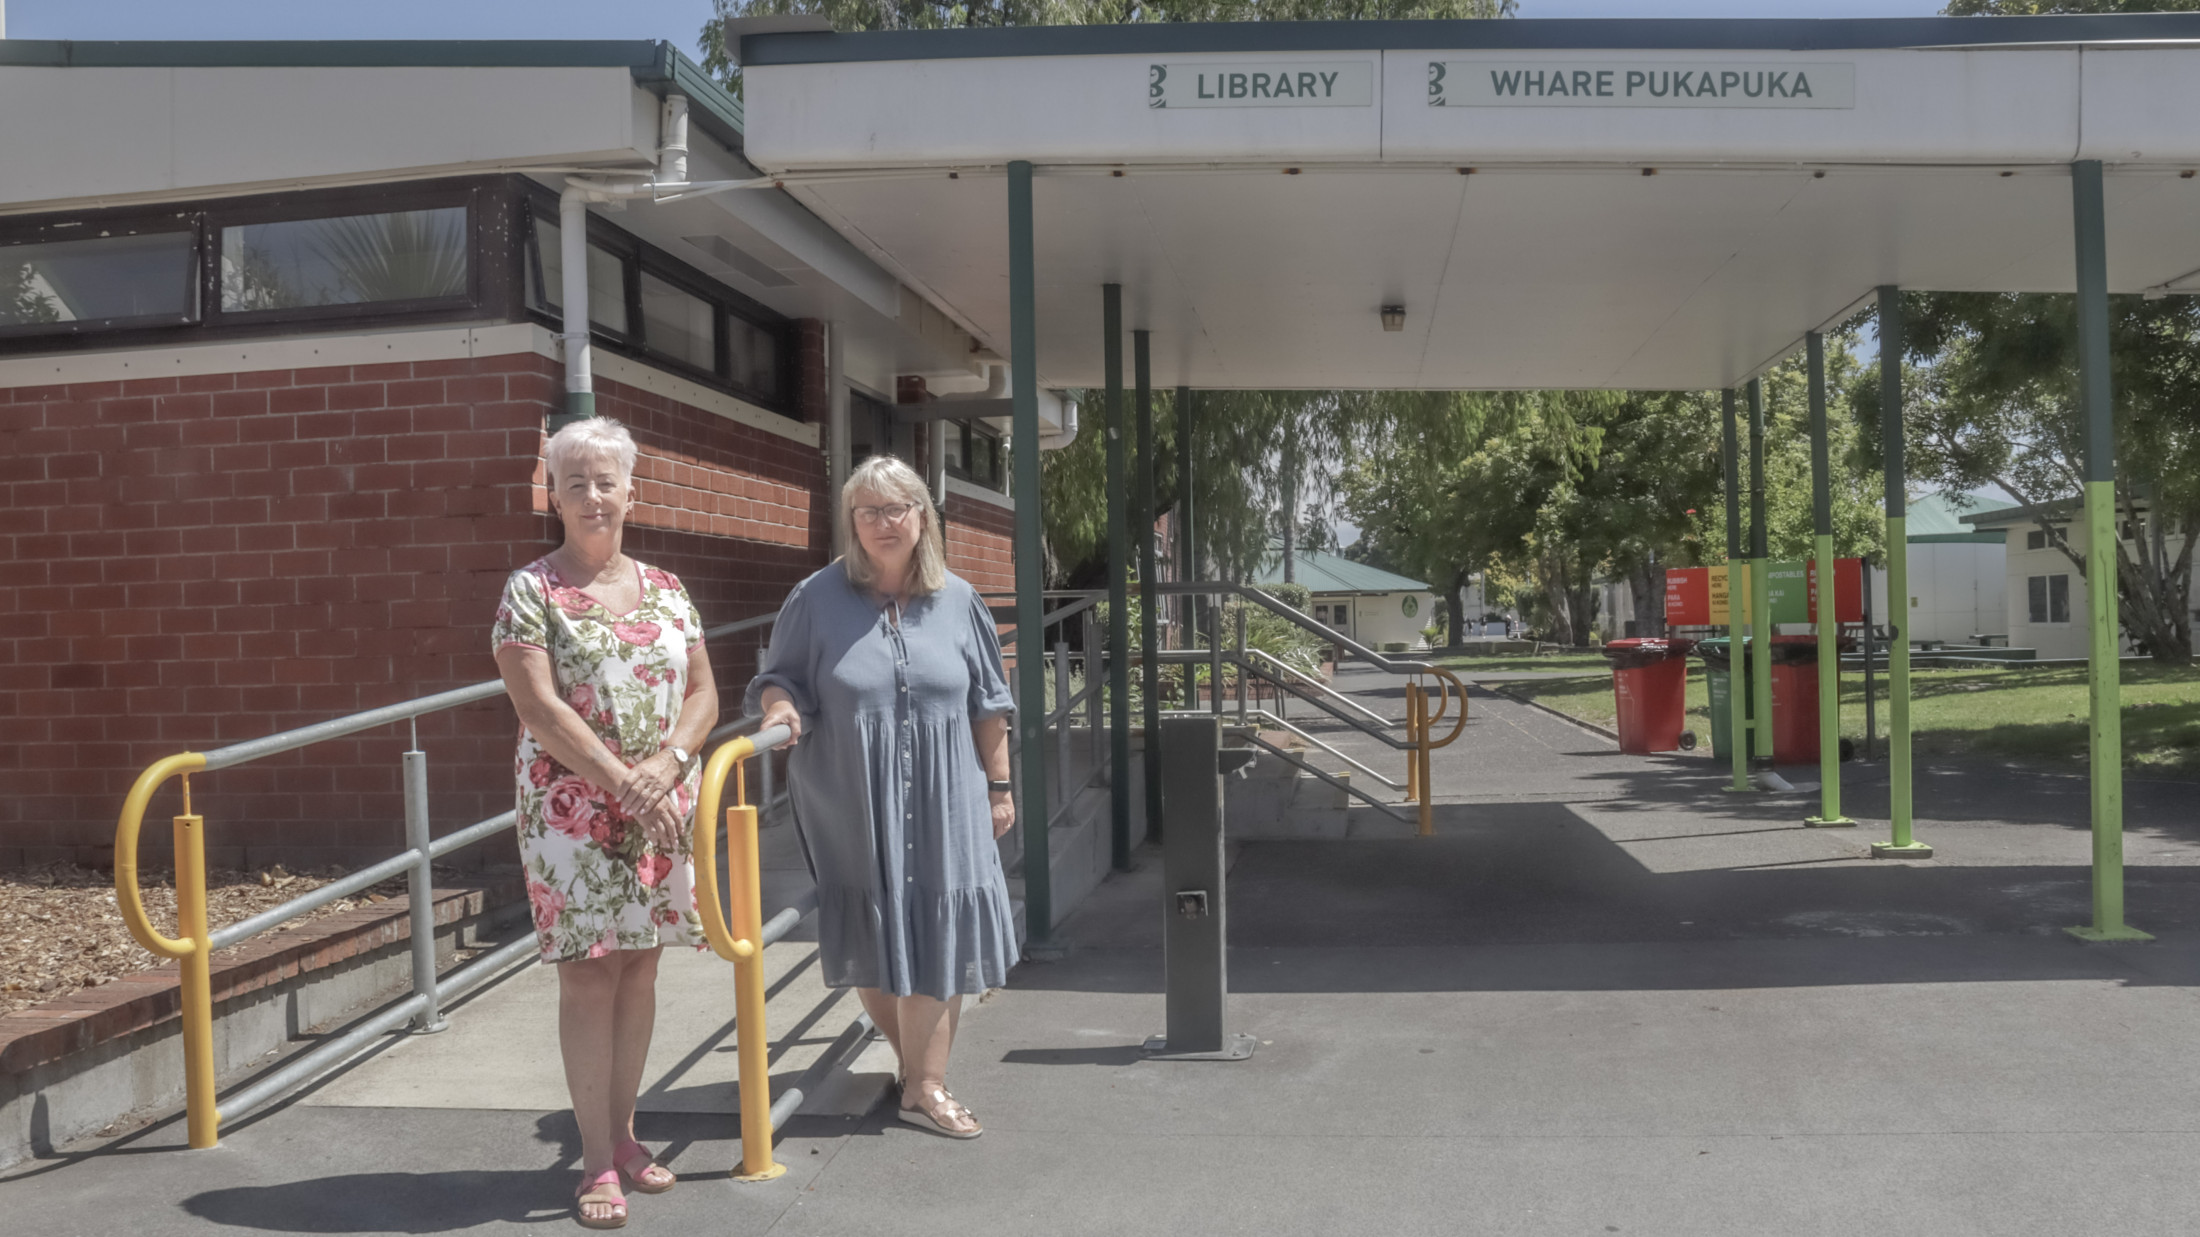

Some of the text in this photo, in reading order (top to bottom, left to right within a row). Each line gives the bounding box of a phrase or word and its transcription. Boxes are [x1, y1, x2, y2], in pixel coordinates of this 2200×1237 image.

[1198, 72, 1339, 99] LIBRARY
[1490, 70, 1813, 98] WHARE PUKAPUKA
